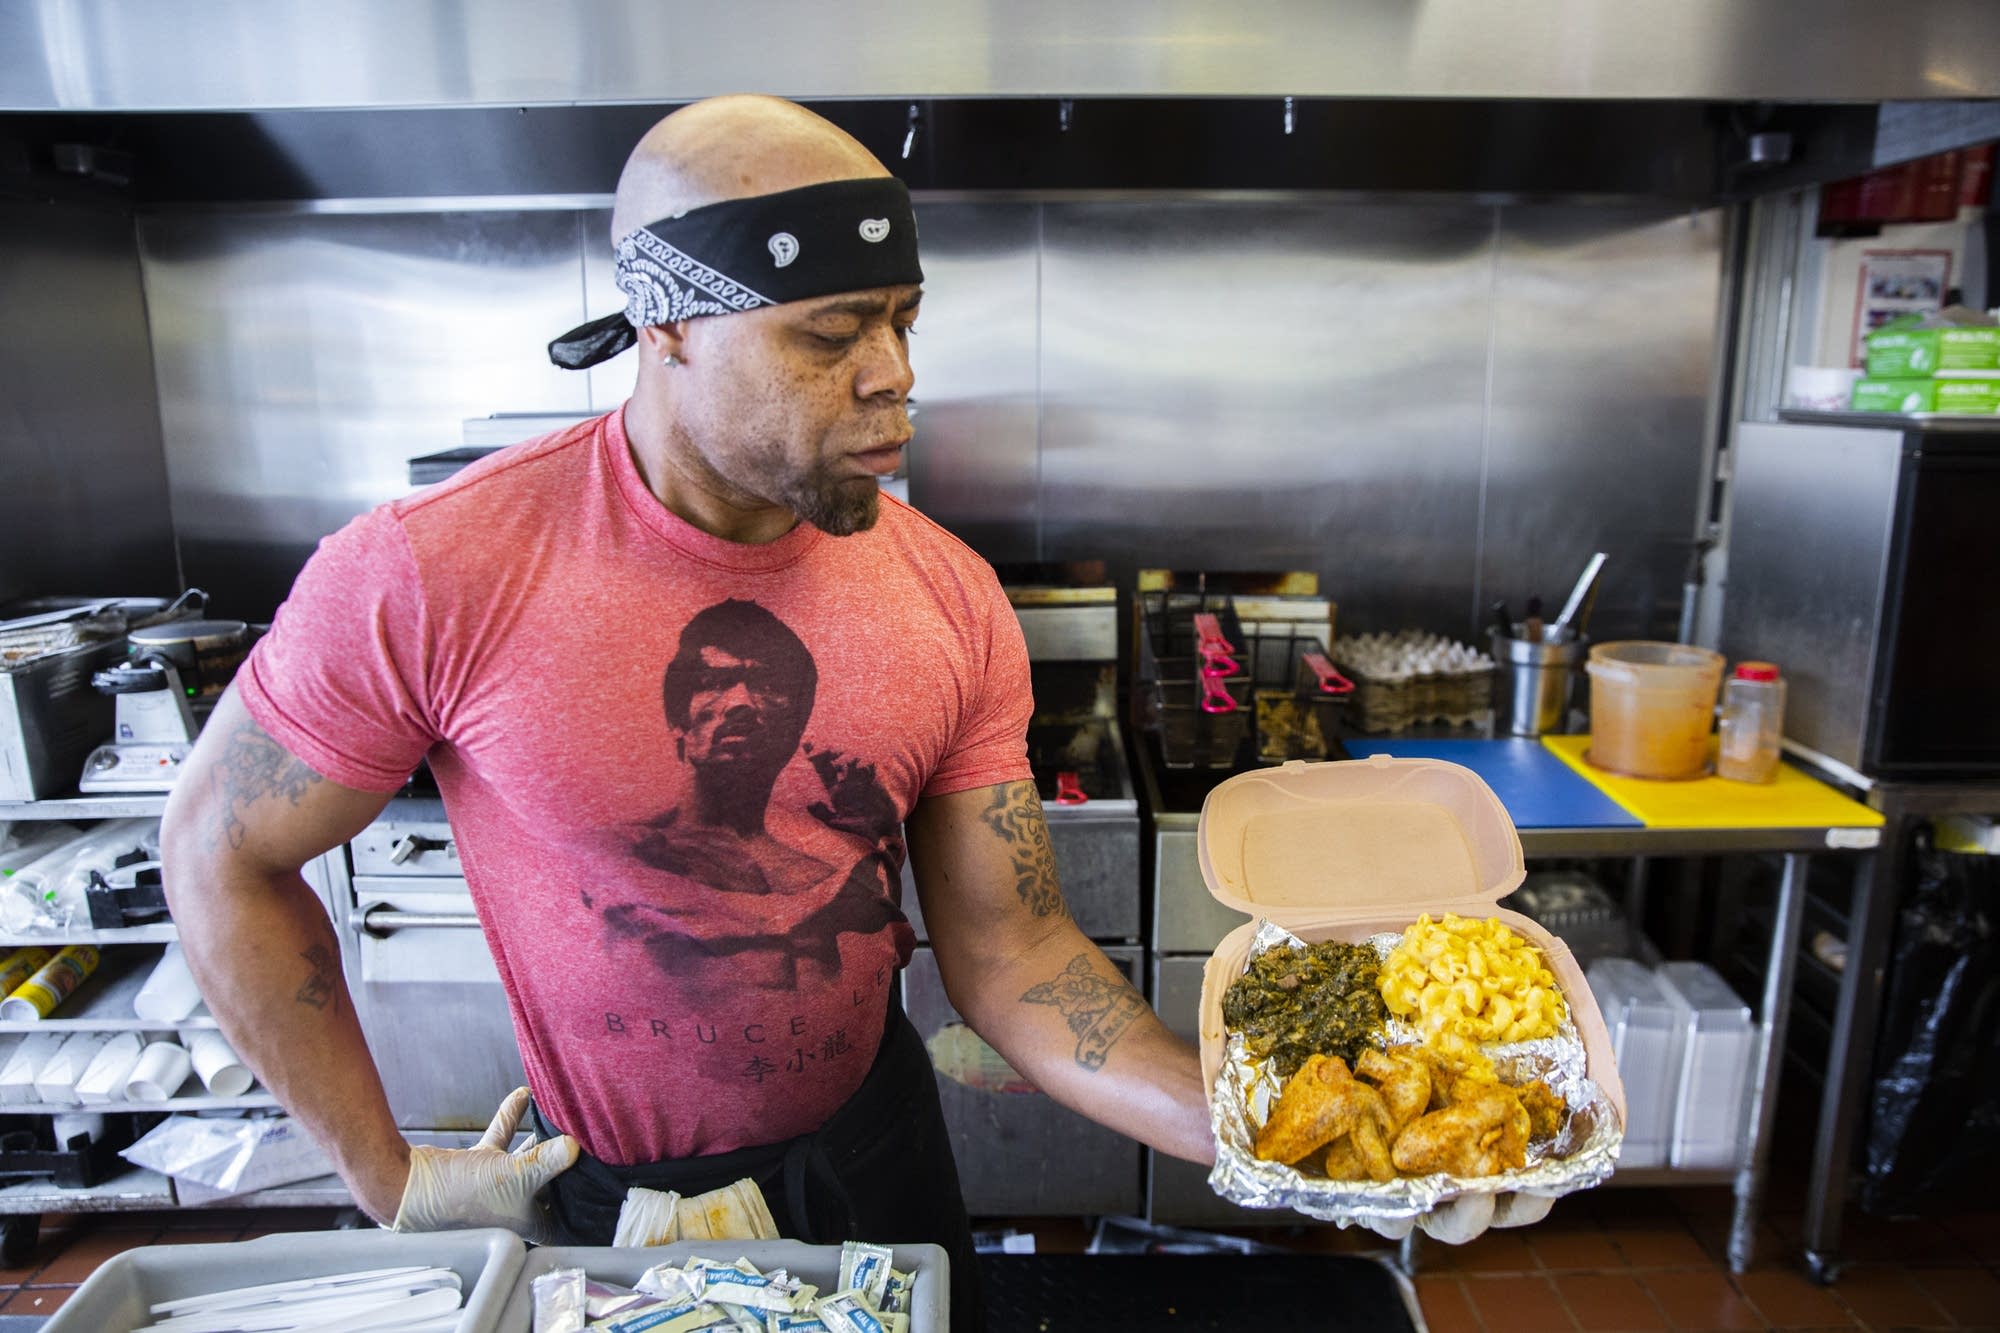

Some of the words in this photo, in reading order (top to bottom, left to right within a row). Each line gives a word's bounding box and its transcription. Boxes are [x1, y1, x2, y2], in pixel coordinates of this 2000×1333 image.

[605, 1012, 806, 1044] BRUCE
[742, 1029, 854, 1083] 李小龍
